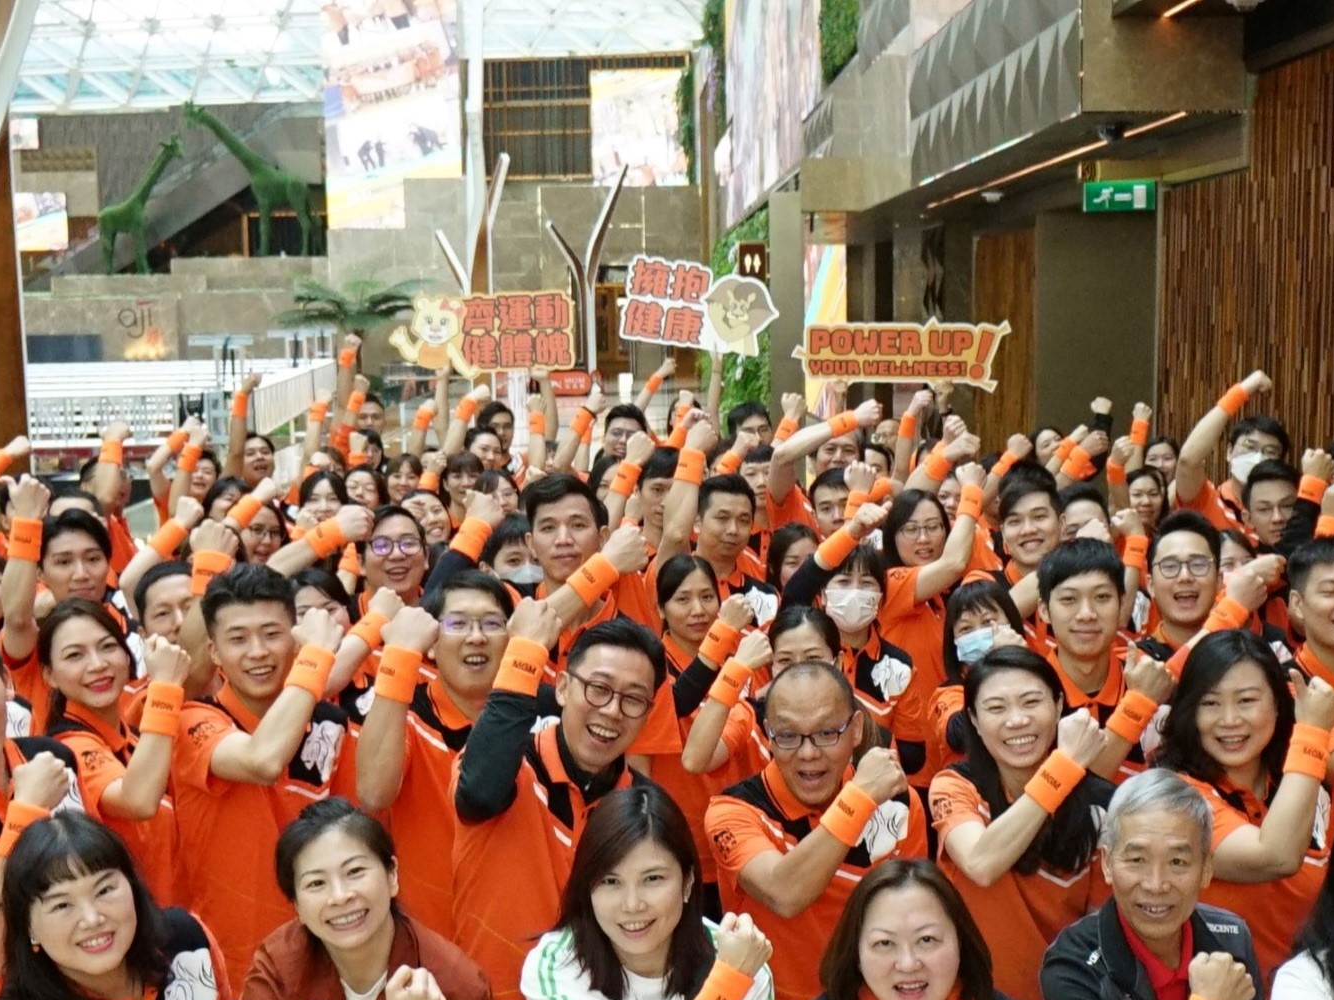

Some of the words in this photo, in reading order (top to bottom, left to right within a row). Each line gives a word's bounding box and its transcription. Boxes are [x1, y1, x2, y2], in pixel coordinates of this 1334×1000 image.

[630, 258, 709, 303] 擁抱
[463, 294, 569, 333] 齊運動
[624, 300, 703, 343] 健康
[462, 331, 571, 369] 健體魄
[809, 328, 922, 356] POWER
[809, 360, 861, 375] YOUR
[863, 361, 966, 377] WELLNESS!
[513, 660, 537, 676] MGM
[1303, 746, 1325, 760] MGM
[1040, 770, 1061, 791] MGM
